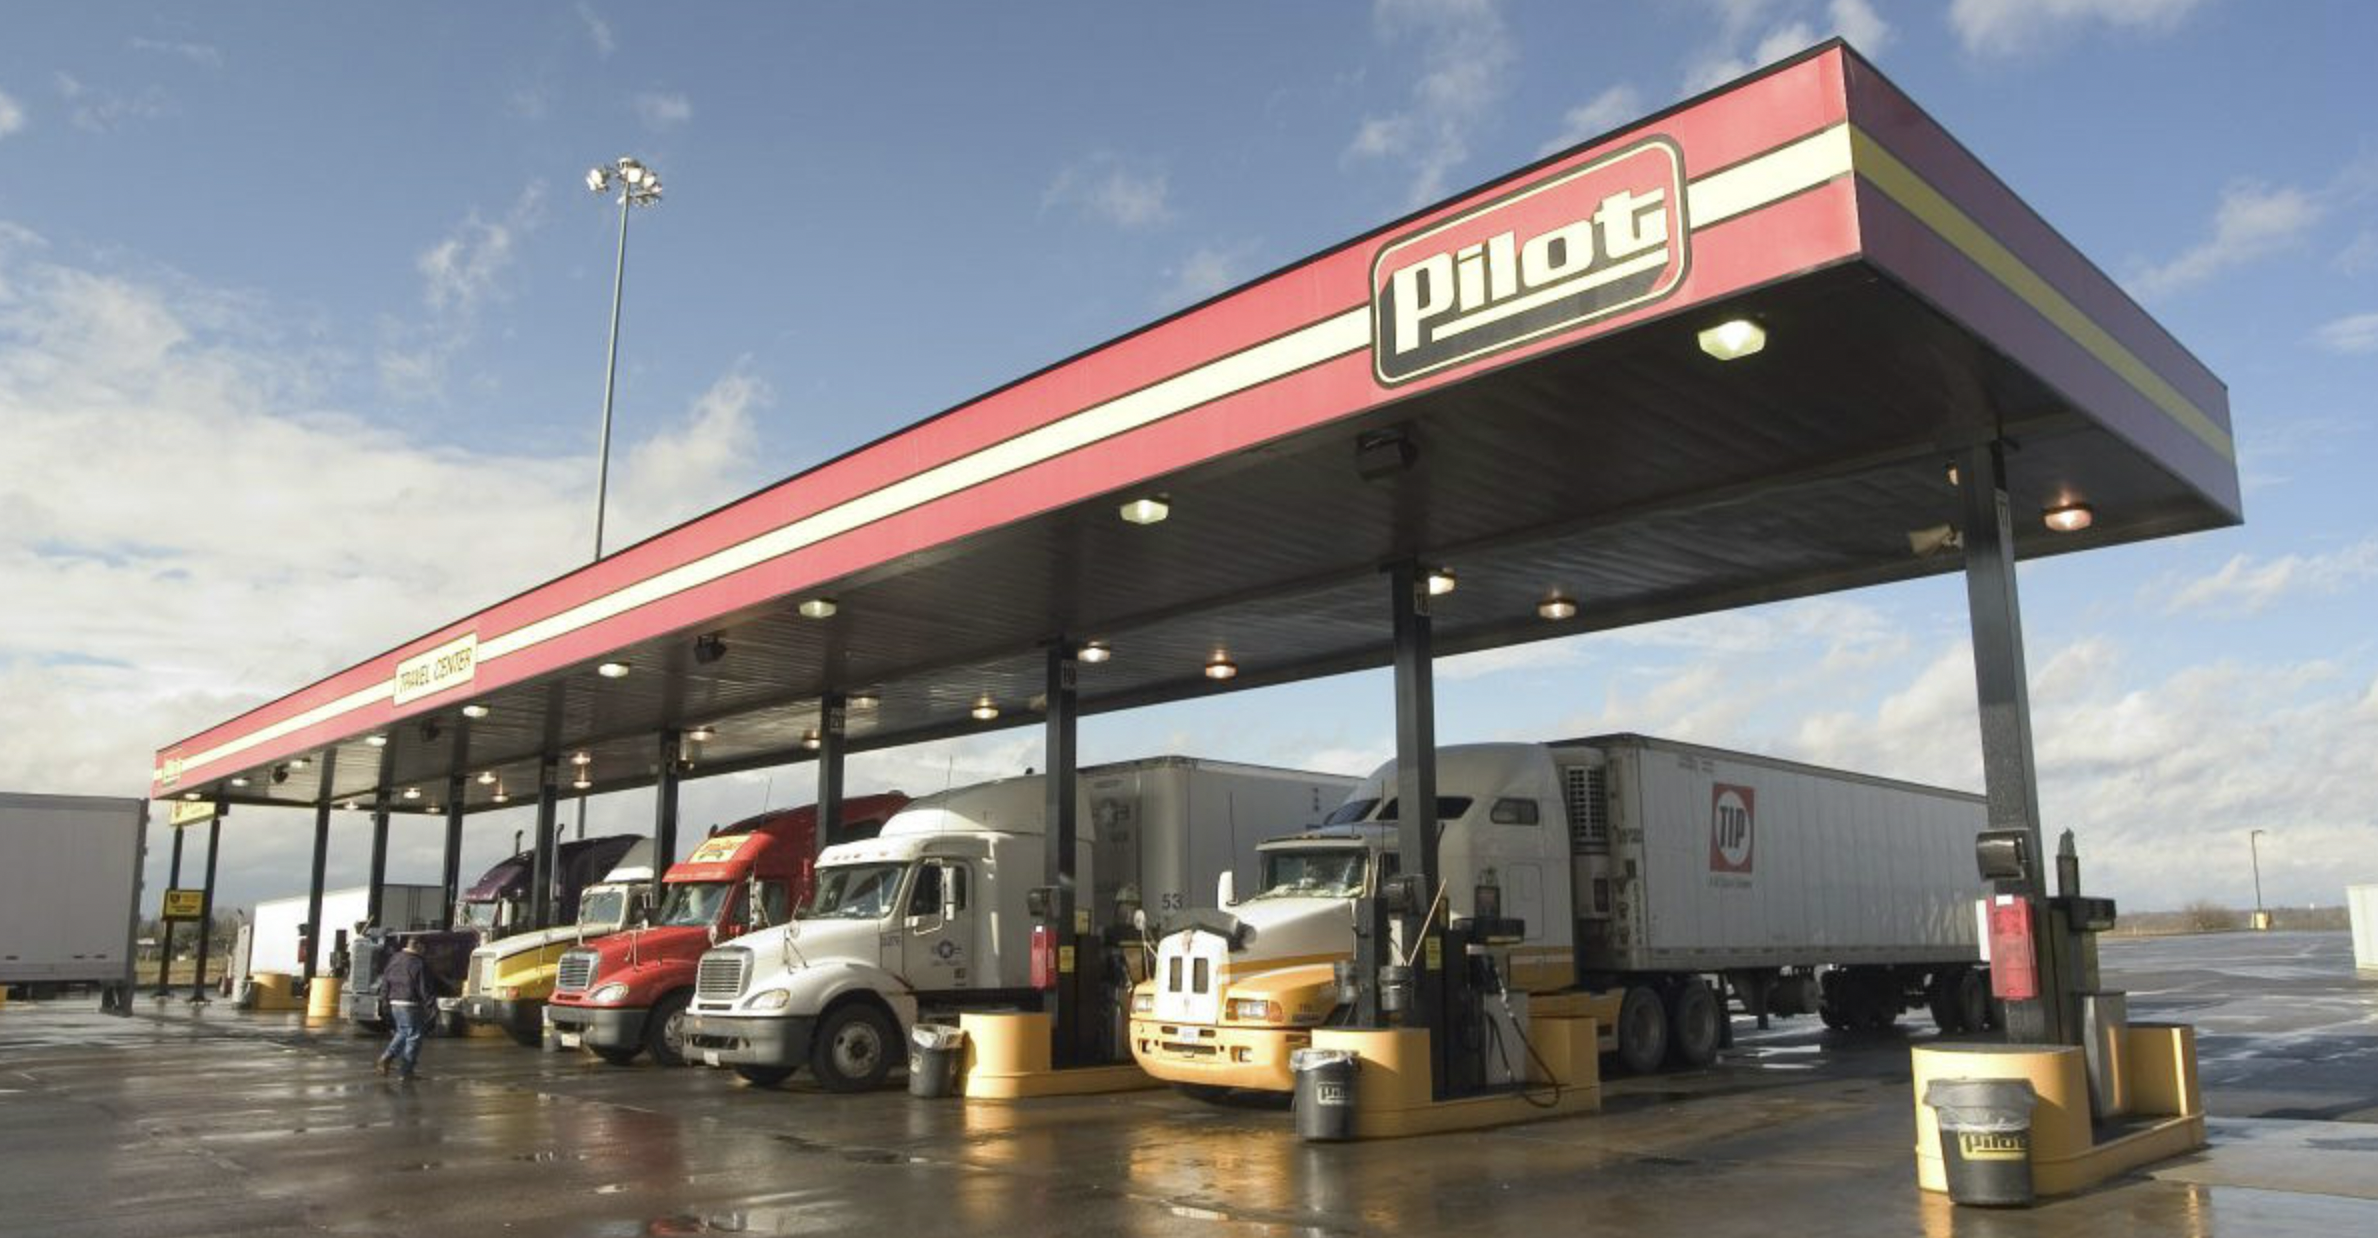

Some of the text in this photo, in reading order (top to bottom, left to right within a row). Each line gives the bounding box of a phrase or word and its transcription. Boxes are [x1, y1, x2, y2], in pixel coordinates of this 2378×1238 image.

[1392, 188, 1670, 356] Pilot
[399, 647, 472, 694] TRAVEL CENTER
[1719, 804, 1747, 849] TIP
[1161, 892, 1183, 910] 53
